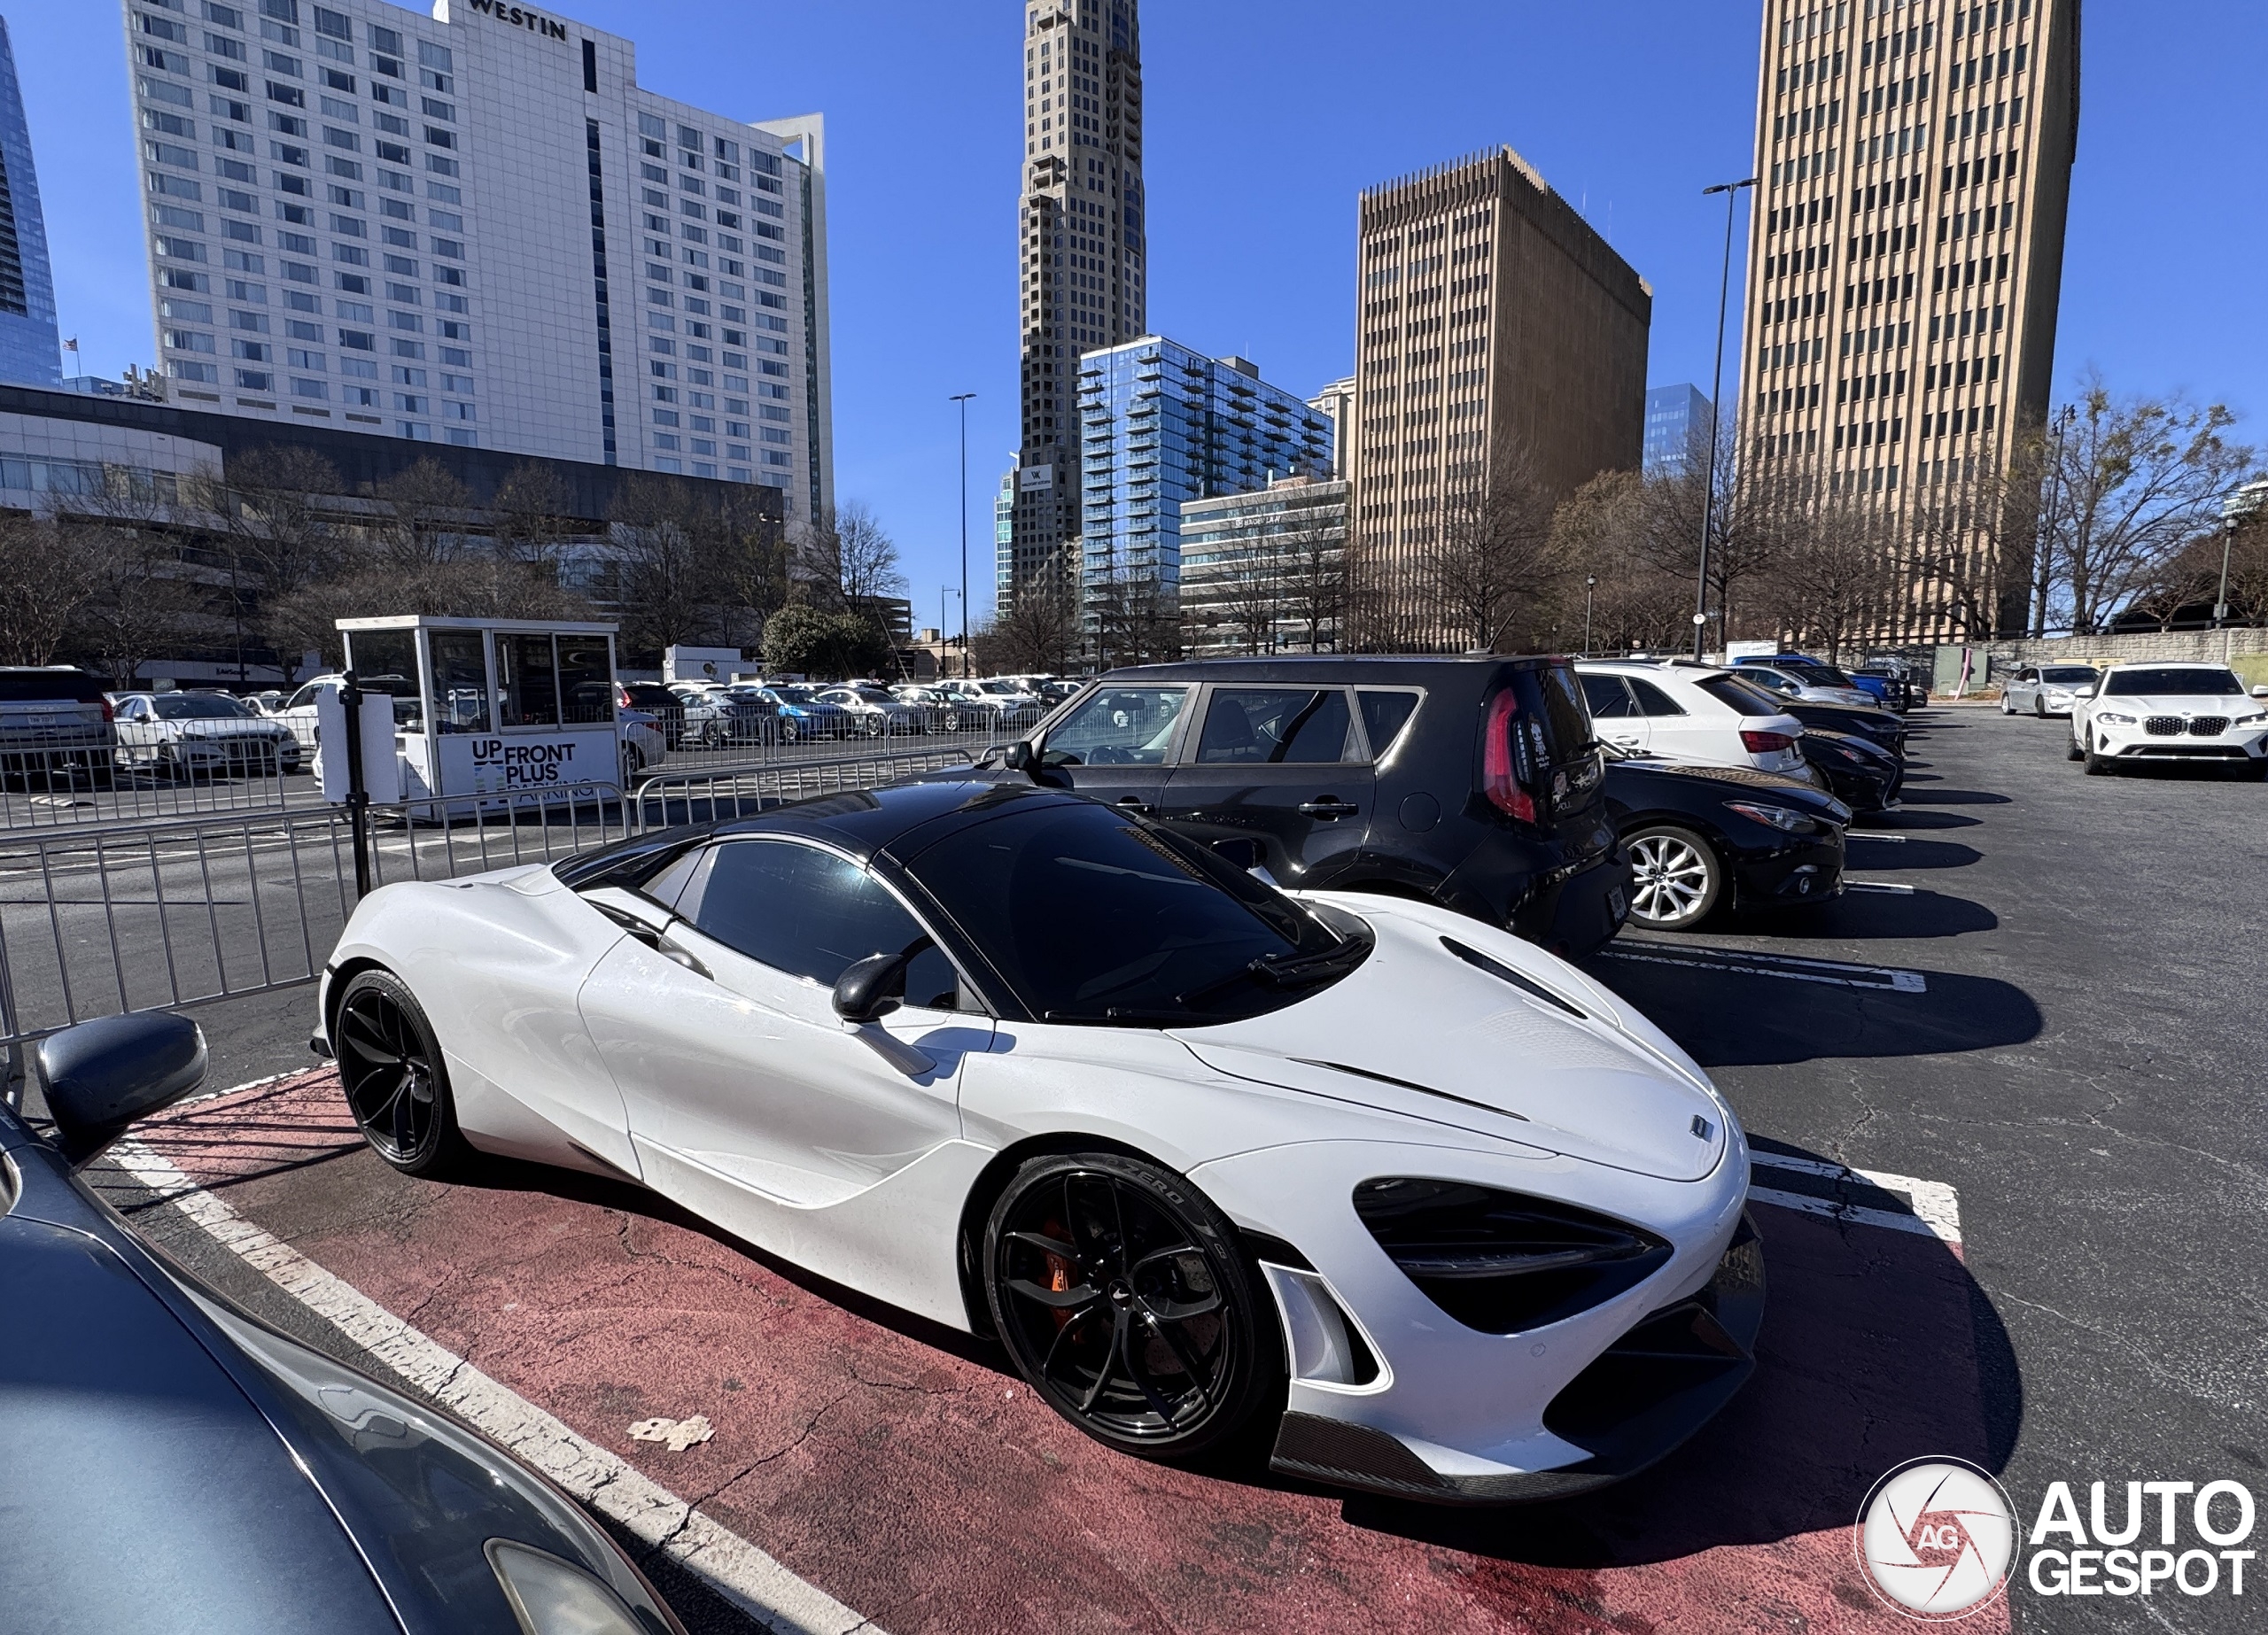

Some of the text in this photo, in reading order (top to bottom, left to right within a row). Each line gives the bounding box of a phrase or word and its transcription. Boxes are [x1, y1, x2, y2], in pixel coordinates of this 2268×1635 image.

[469, 0, 566, 41] WESTIN
[472, 740, 502, 759] UP
[505, 744, 576, 764] FRONT
[507, 763, 558, 784] PLUS
[508, 779, 594, 802] ARKING
[1122, 1164, 1185, 1205] ZERO
